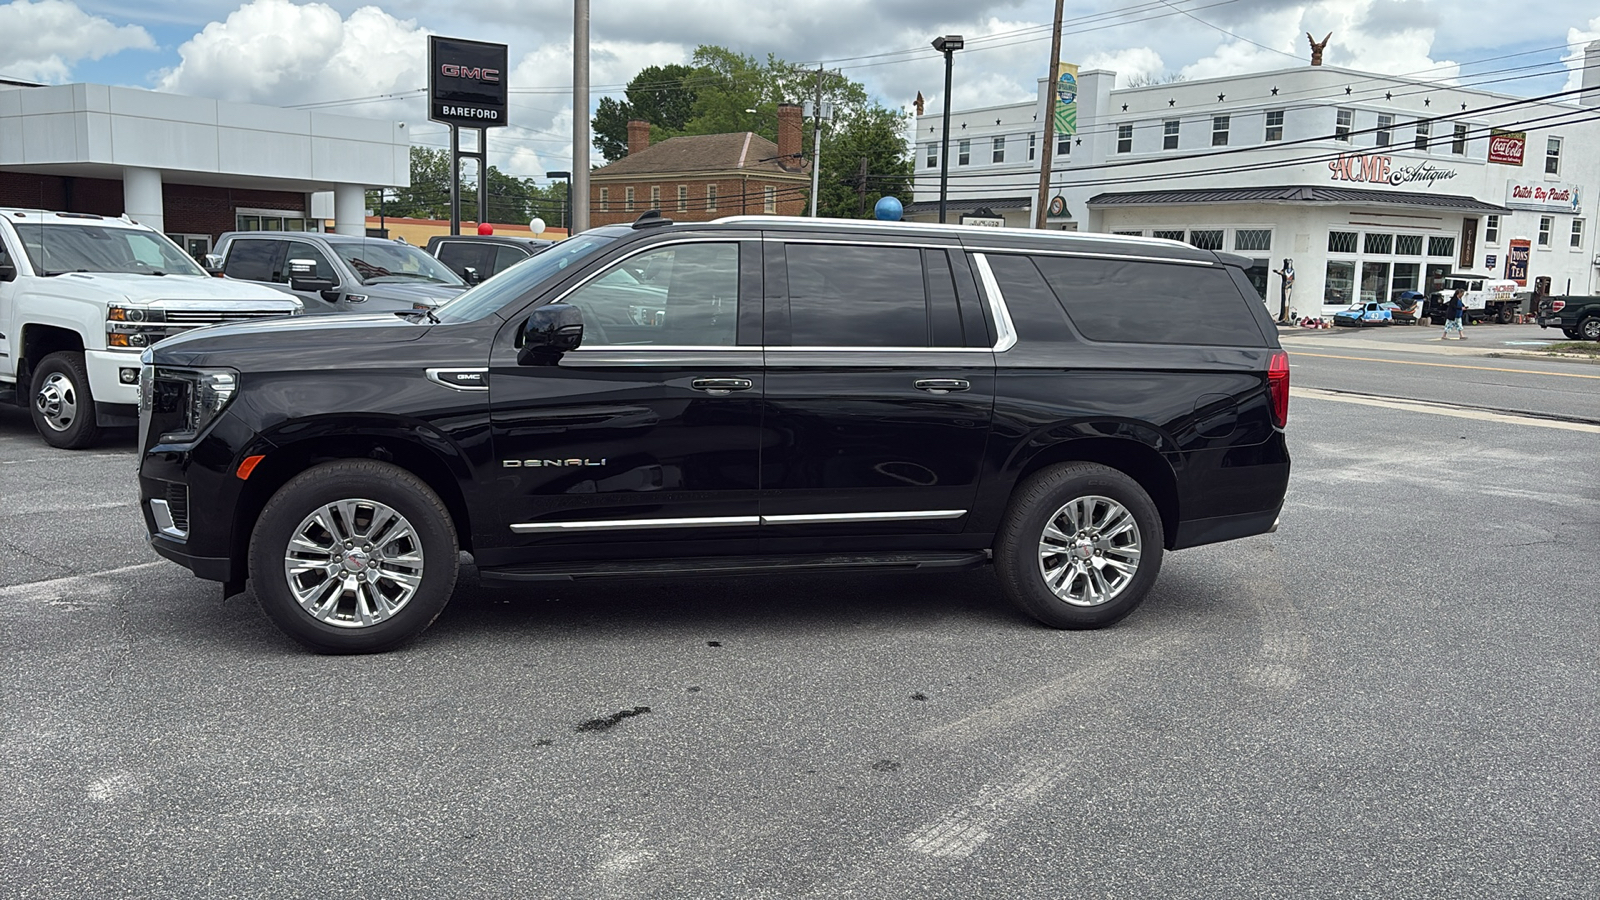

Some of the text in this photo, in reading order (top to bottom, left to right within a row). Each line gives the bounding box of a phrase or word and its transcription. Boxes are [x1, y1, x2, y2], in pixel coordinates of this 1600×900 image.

[441, 63, 499, 81] GMC
[442, 105, 498, 120] BAREFORD
[1328, 152, 1457, 187] ACME Antiques
[1512, 185, 1570, 203] Dutch Boy Paints
[502, 458, 607, 468] DENALI
